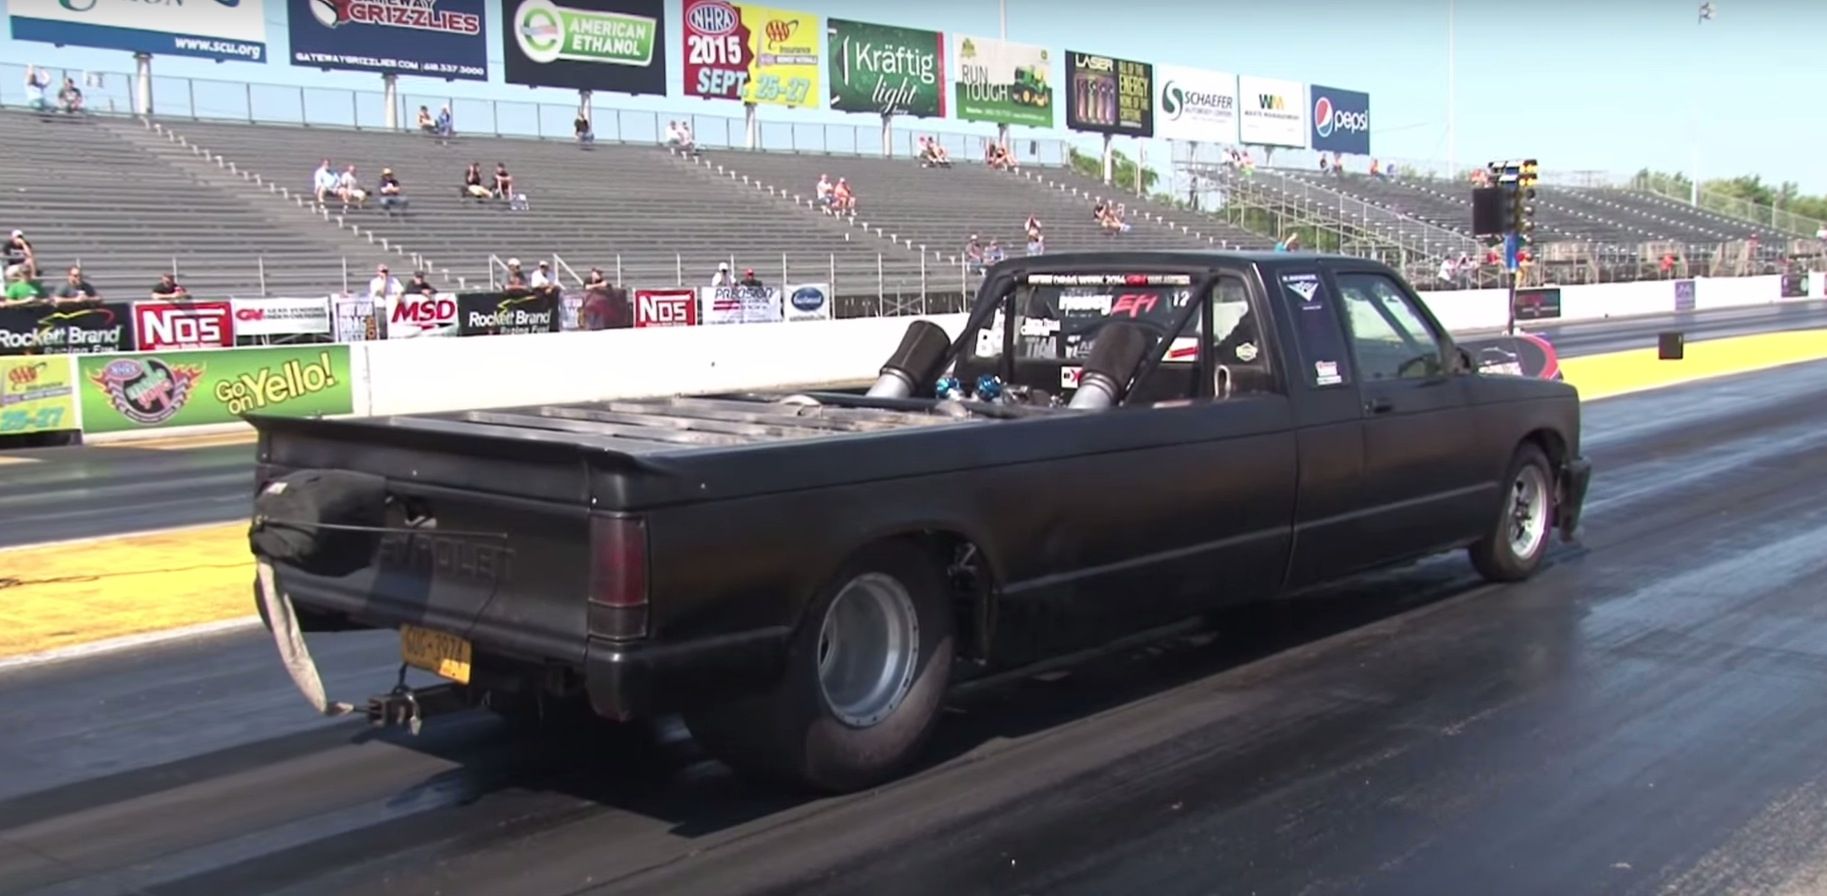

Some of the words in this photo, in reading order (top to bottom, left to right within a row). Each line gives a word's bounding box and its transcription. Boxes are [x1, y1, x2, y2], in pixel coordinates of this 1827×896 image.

[350, 4, 479, 35] GRIZZLIES
[570, 17, 646, 39] AMERICAN
[693, 6, 732, 32] NHRA
[174, 37, 261, 60] www.scu.org
[572, 35, 641, 56] ETHANOL
[688, 35, 742, 65] 2015
[855, 41, 935, 84] Kräftig
[962, 64, 989, 84] RUN
[1075, 53, 1114, 72] LASER
[755, 74, 811, 103] 25-27
[872, 74, 918, 114] light
[964, 82, 1009, 102] TOUGH
[1184, 91, 1233, 109] SCHAEFER
[1334, 109, 1369, 134] pepsi
[391, 300, 456, 323] MSD
[515, 309, 551, 325] Brand
[638, 295, 691, 322] NOS
[68, 325, 120, 344] Brand
[142, 308, 226, 344] NOS
[216, 379, 245, 401] Go
[240, 351, 336, 407] Yello!
[228, 394, 254, 415] on
